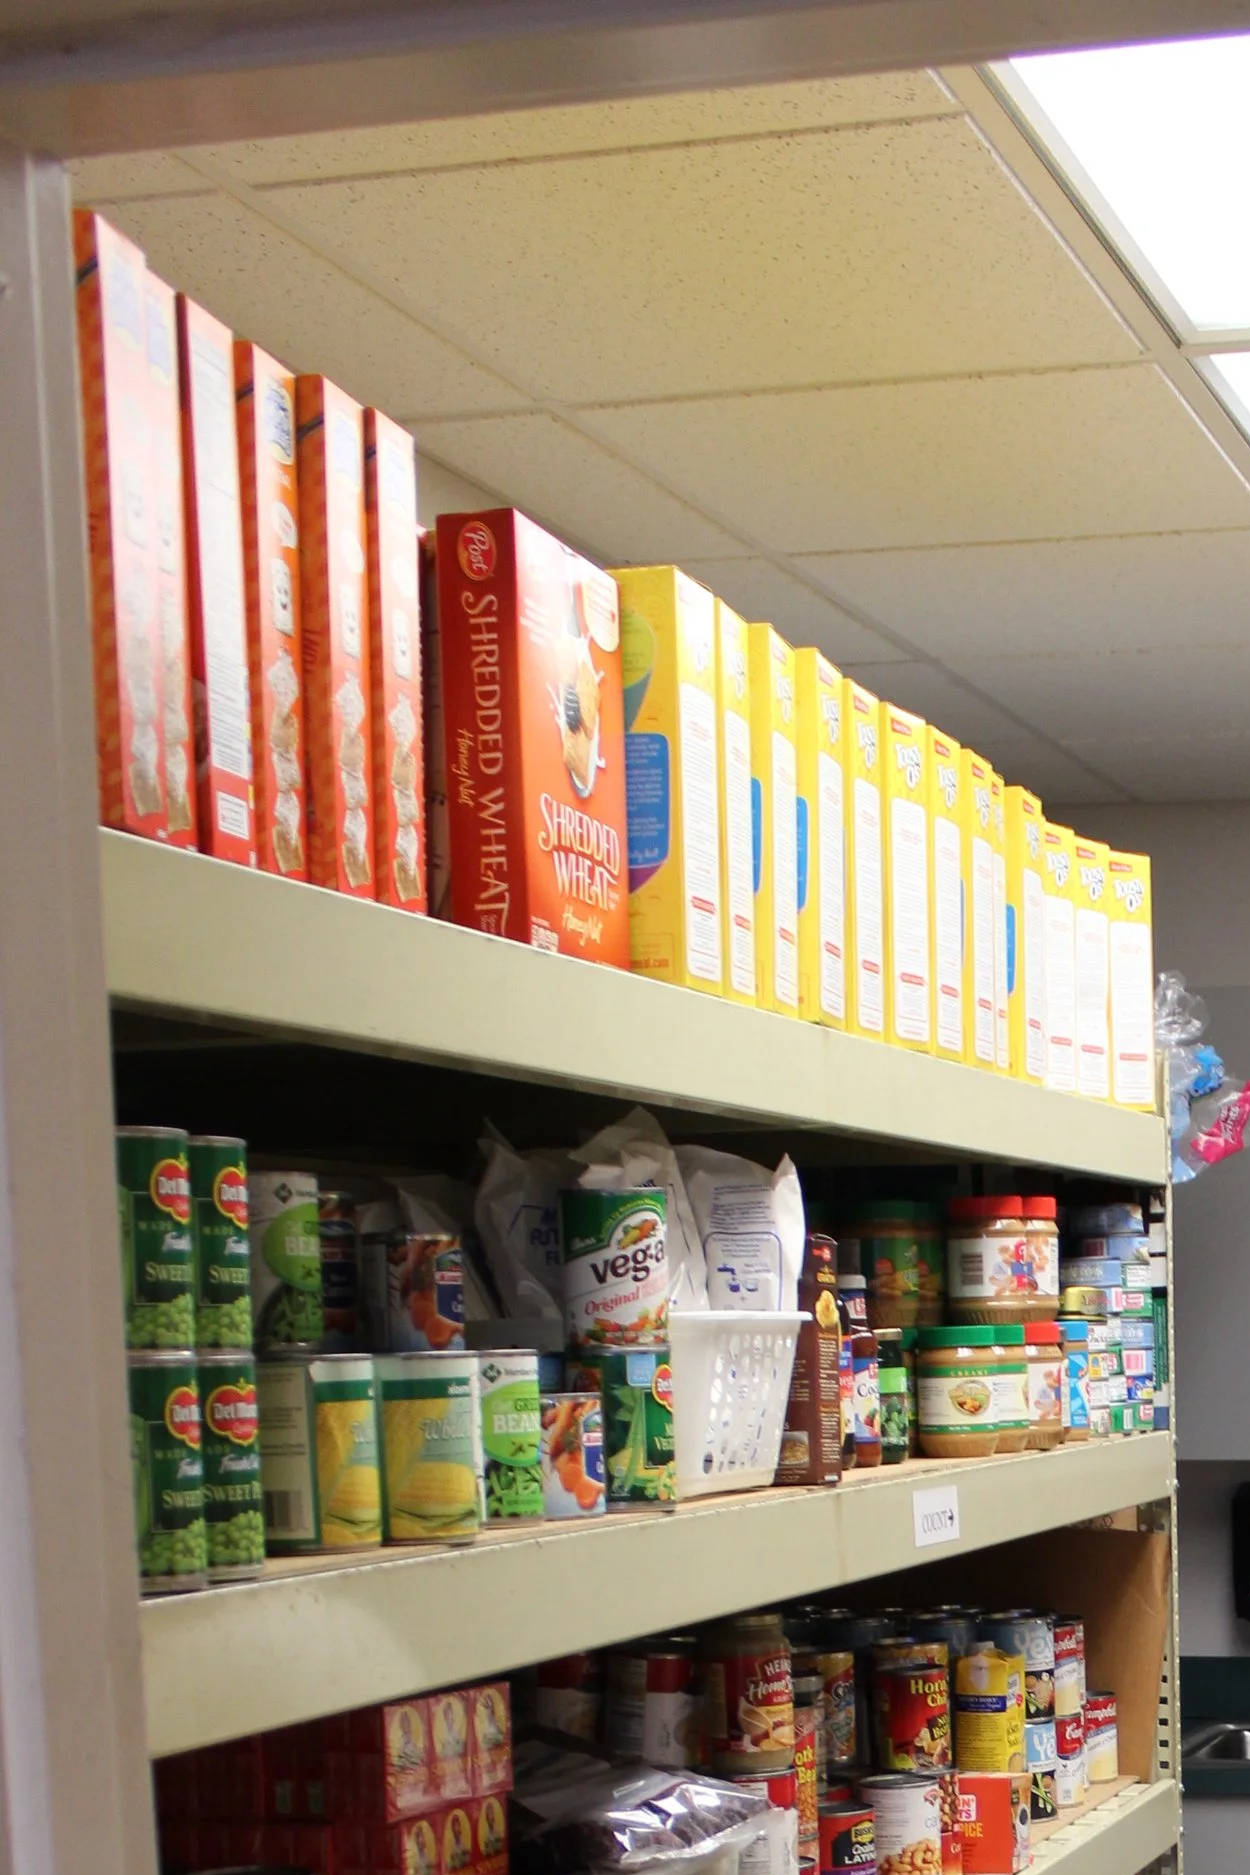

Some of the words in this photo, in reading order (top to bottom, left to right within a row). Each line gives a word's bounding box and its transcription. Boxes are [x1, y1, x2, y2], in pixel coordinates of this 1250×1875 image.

[461, 528, 493, 578] Post
[461, 592, 502, 777] SHREDDED
[474, 788, 510, 938] WHEAT
[538, 792, 620, 878] SHREDDED
[553, 849, 617, 912] WHEAT
[584, 1286, 641, 1317] Original
